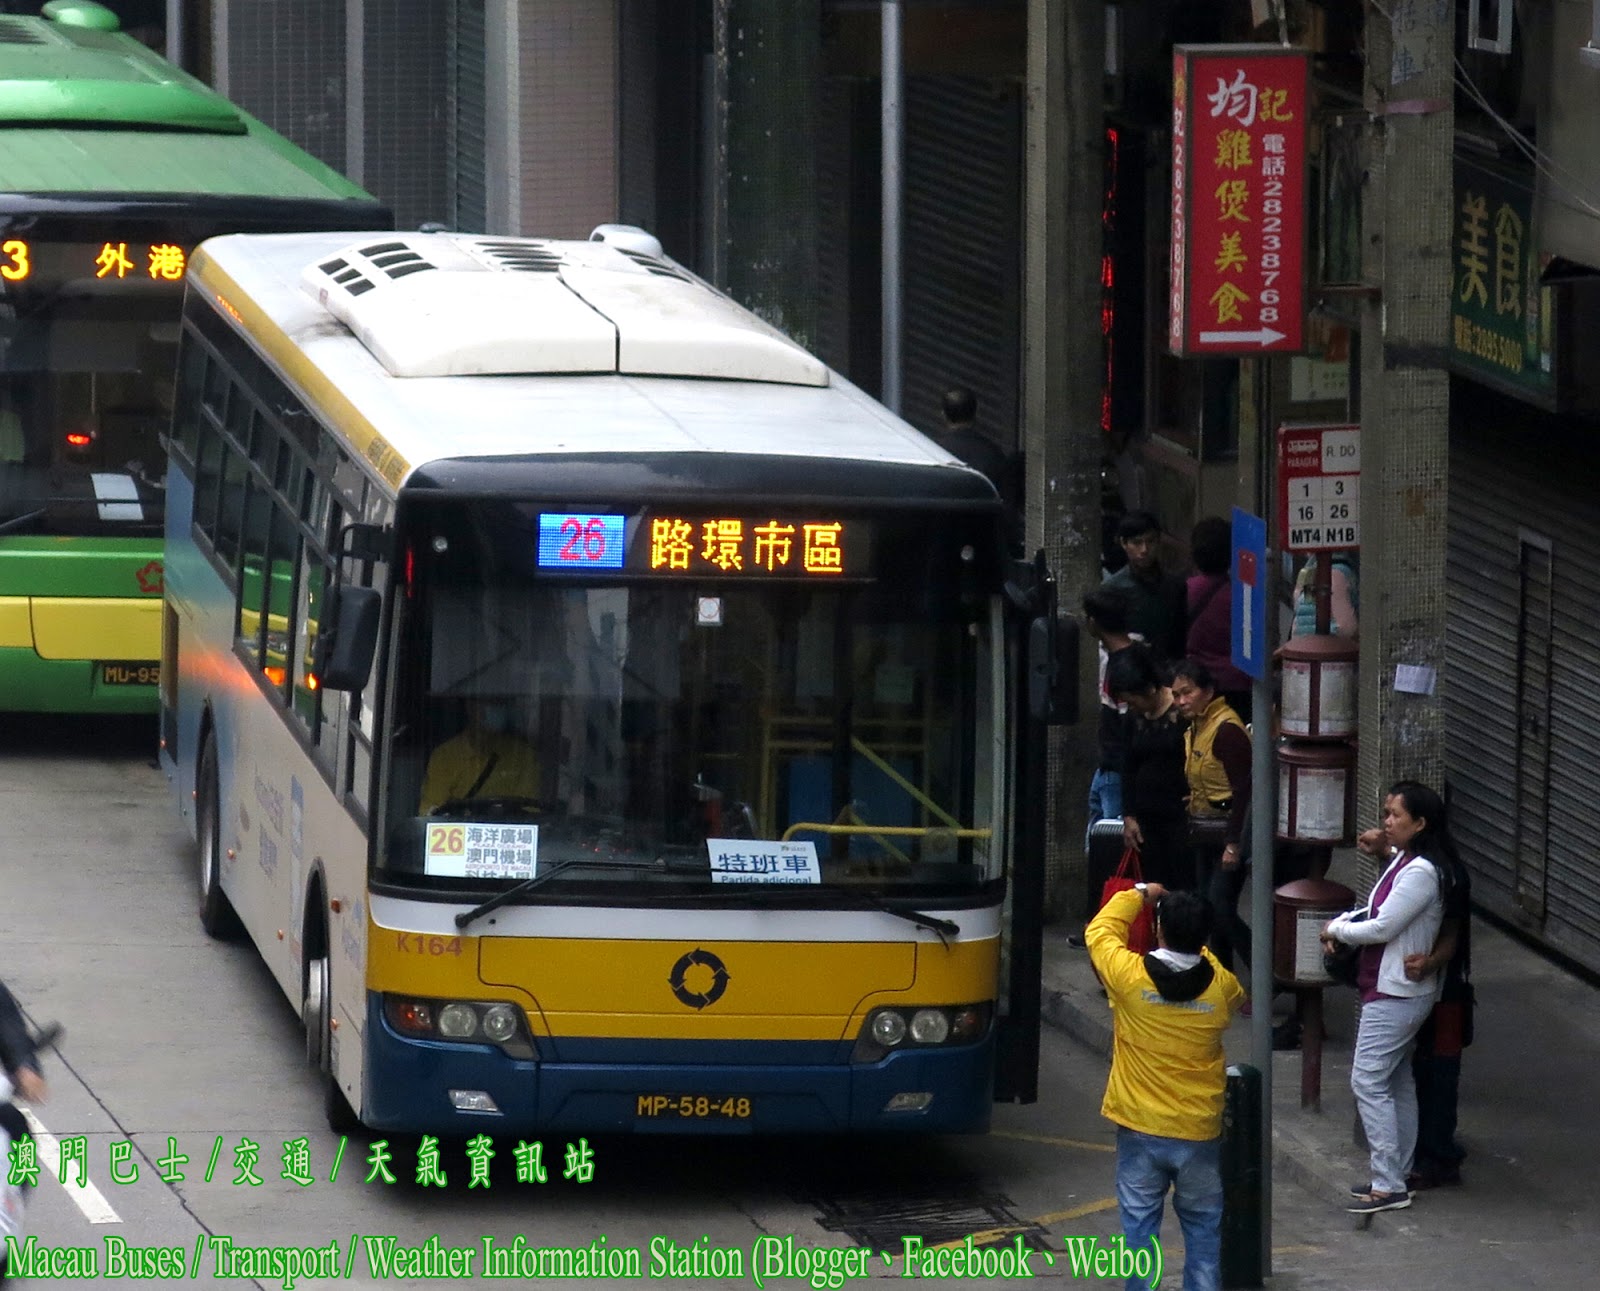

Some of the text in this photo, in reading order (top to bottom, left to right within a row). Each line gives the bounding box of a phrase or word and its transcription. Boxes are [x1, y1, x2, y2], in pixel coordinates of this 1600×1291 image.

[1207, 69, 1294, 127] 均記
[1, 239, 186, 280] 3 外港
[1302, 481, 1344, 497] 1 3
[1298, 504, 1349, 520] 16 26
[559, 516, 843, 572] 26 路環市區
[1291, 527, 1355, 544] MT4 N1B
[430, 828, 463, 853] 26
[467, 827, 533, 844] 海洋廣場
[466, 848, 532, 866] 澳門機場
[718, 853, 812, 874] 特班車
[397, 932, 462, 957] K164
[637, 1096, 751, 1118] MP-58-48
